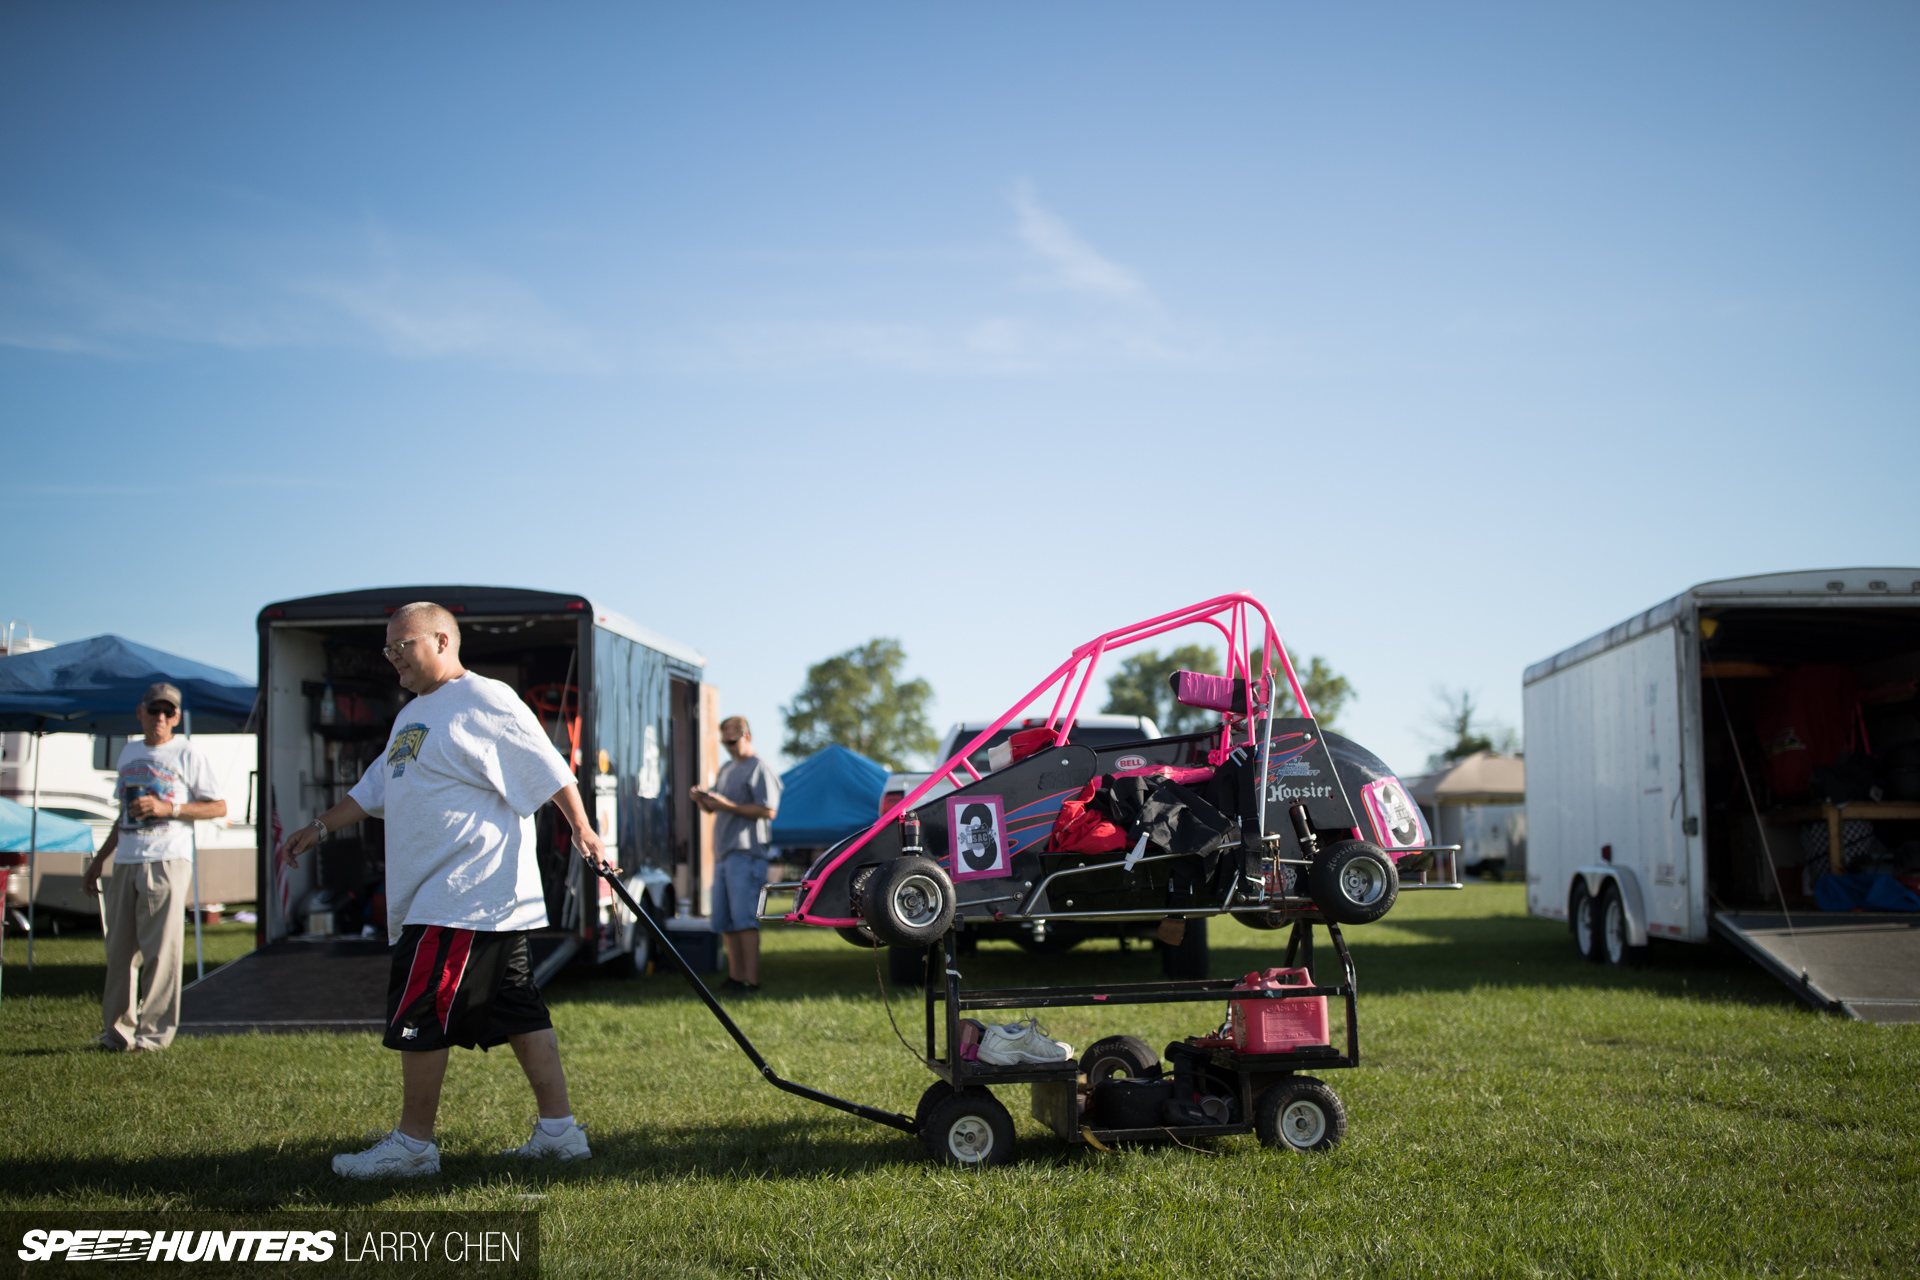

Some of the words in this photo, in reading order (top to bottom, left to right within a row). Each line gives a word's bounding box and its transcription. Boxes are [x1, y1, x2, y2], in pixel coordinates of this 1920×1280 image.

[1120, 759, 1142, 767] BELL
[1269, 782, 1332, 802] Hoosier
[1383, 783, 1417, 845] 3
[960, 803, 997, 871] 3
[967, 833, 988, 844] USAC
[1327, 843, 1357, 872] Hoosier
[1368, 893, 1396, 919] Hoosier
[1266, 1002, 1317, 1013] GASOLNE
[1093, 1042, 1129, 1057] Hoosier
